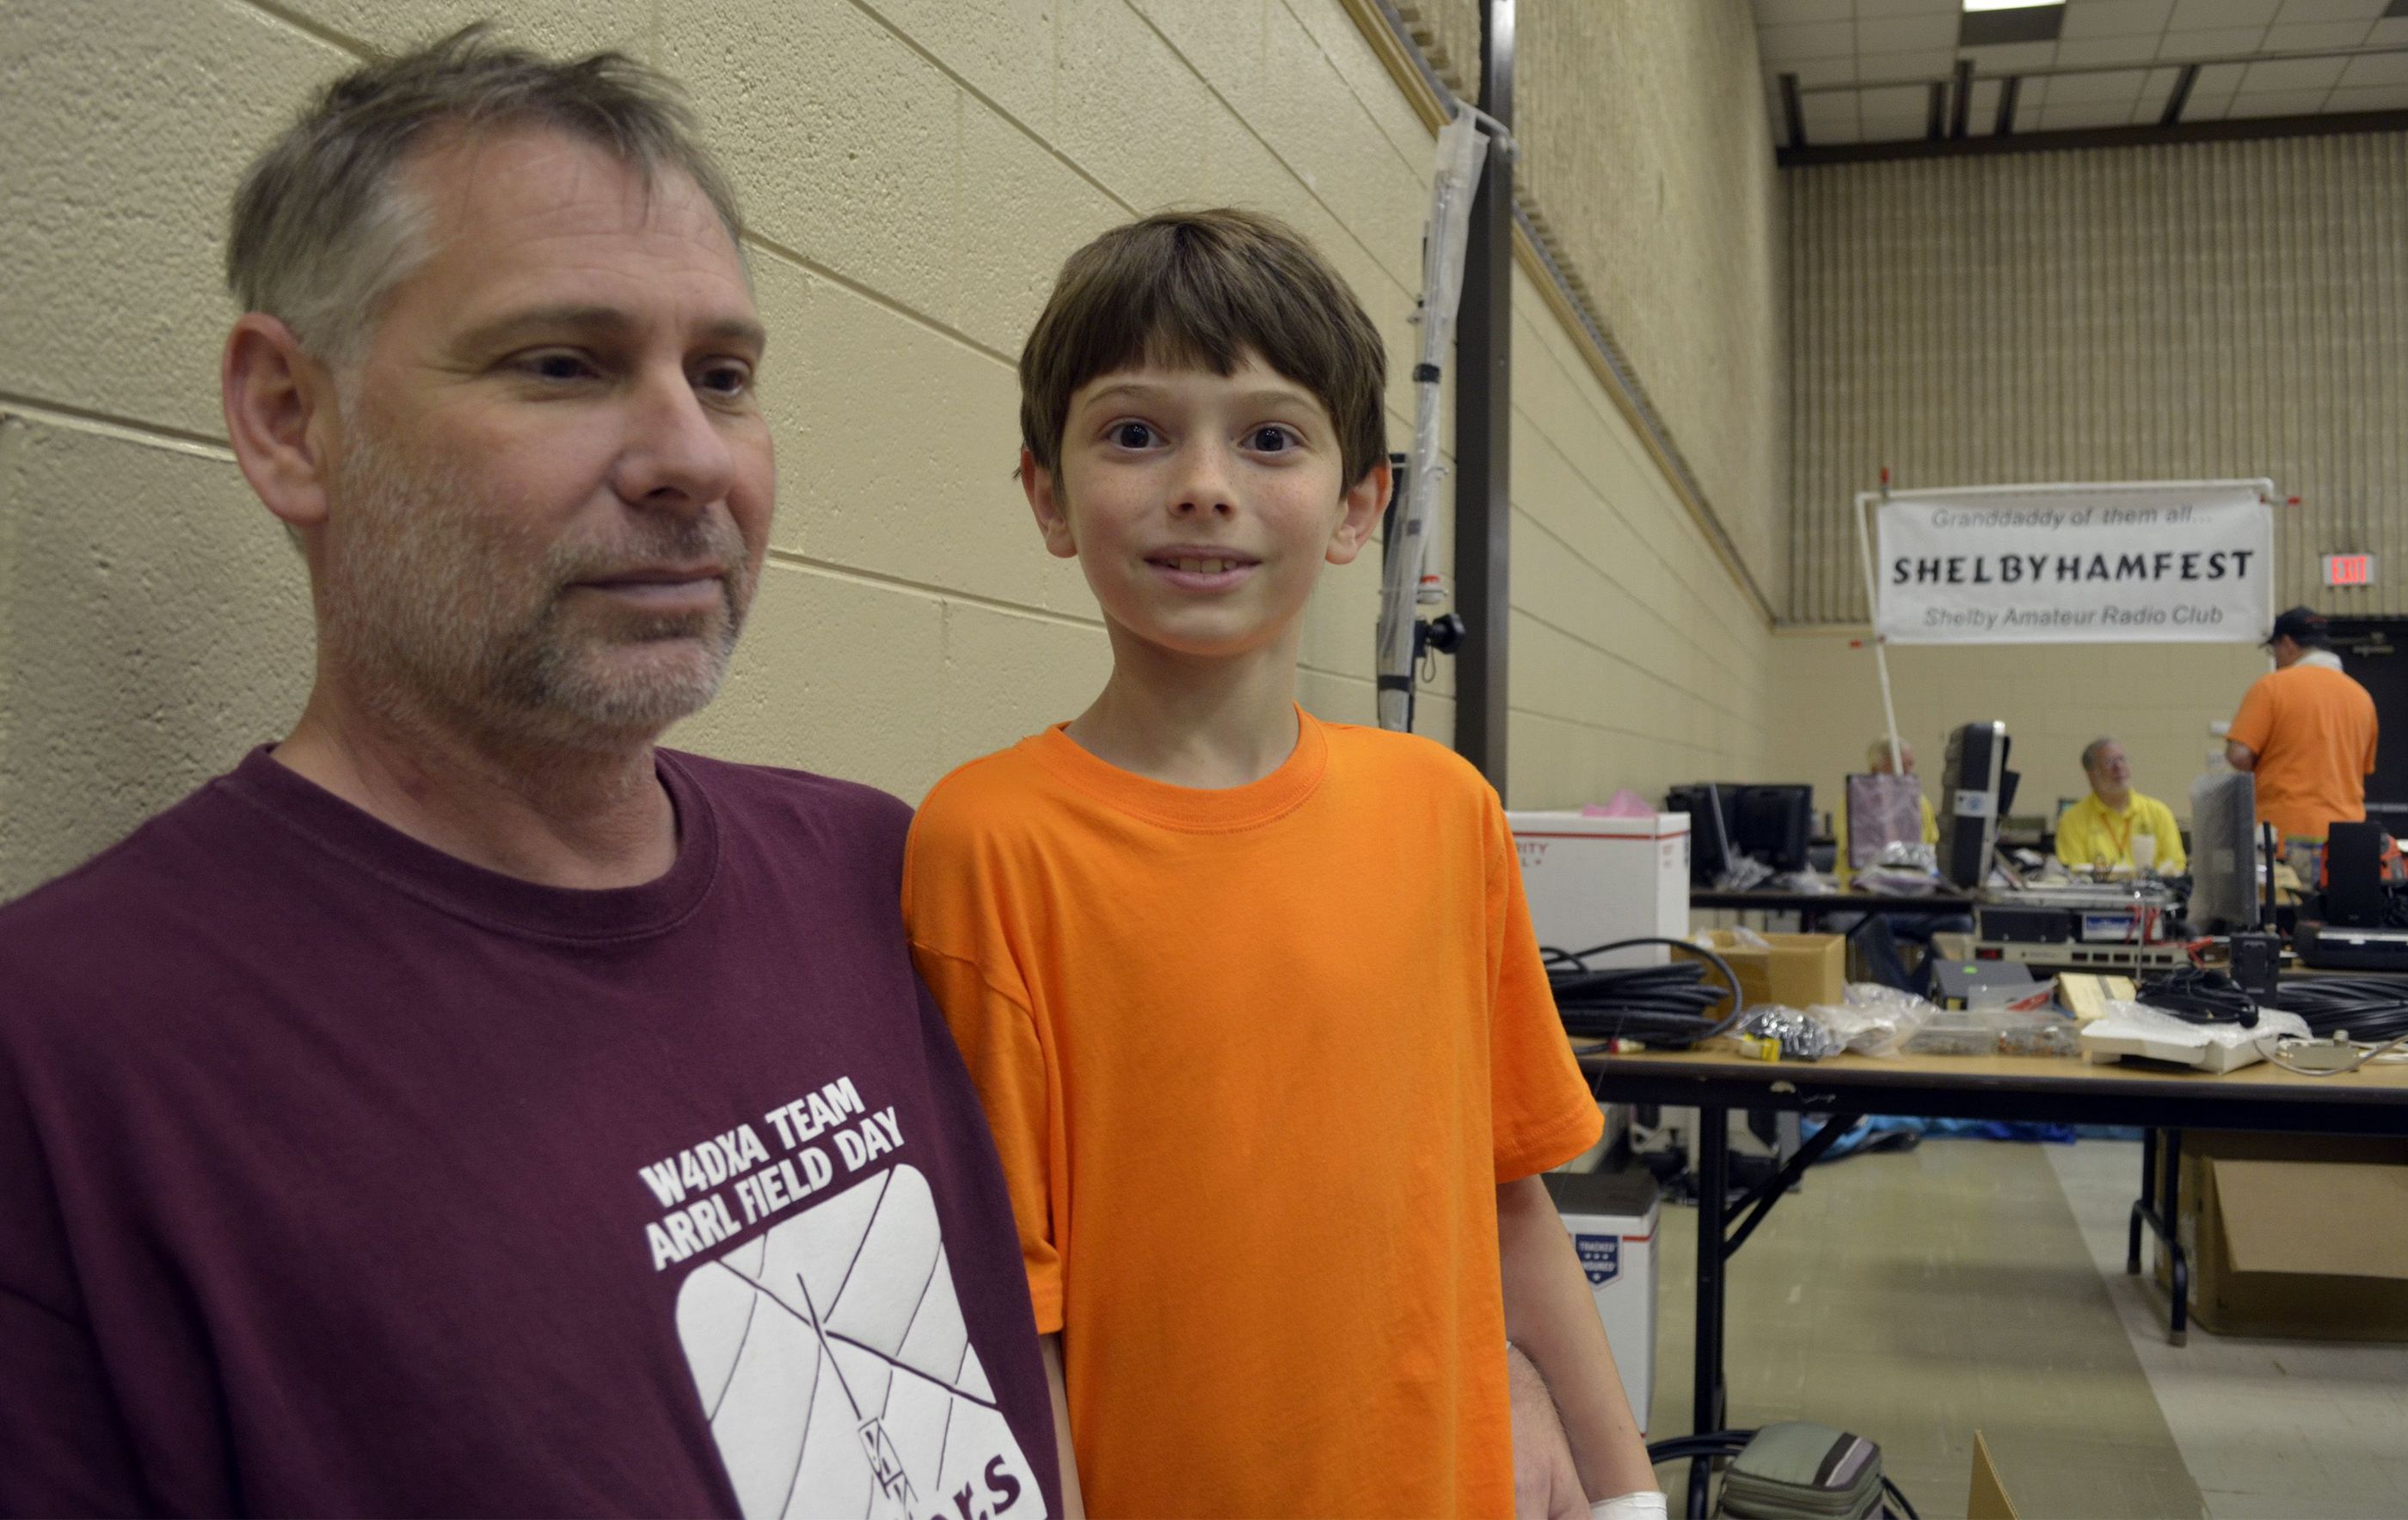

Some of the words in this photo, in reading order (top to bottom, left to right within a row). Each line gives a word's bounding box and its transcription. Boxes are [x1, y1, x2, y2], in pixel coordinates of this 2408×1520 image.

[1932, 507, 2064, 531] Granddaddy
[2069, 505, 2092, 526] of
[2103, 506, 2158, 525] them
[2331, 555, 2367, 585] EXIT
[1924, 607, 1998, 631] Shelby
[2004, 606, 2097, 626] Amateur
[2102, 604, 2166, 625] Radio
[2172, 603, 2224, 625] Club
[639, 1123, 770, 1208] W4DXA
[765, 1076, 865, 1150] TEAM
[645, 1196, 741, 1271] ARRL
[734, 1148, 833, 1225] FIELD
[833, 1106, 905, 1172] DAY
[1582, 1261, 1616, 1272] NSURED
